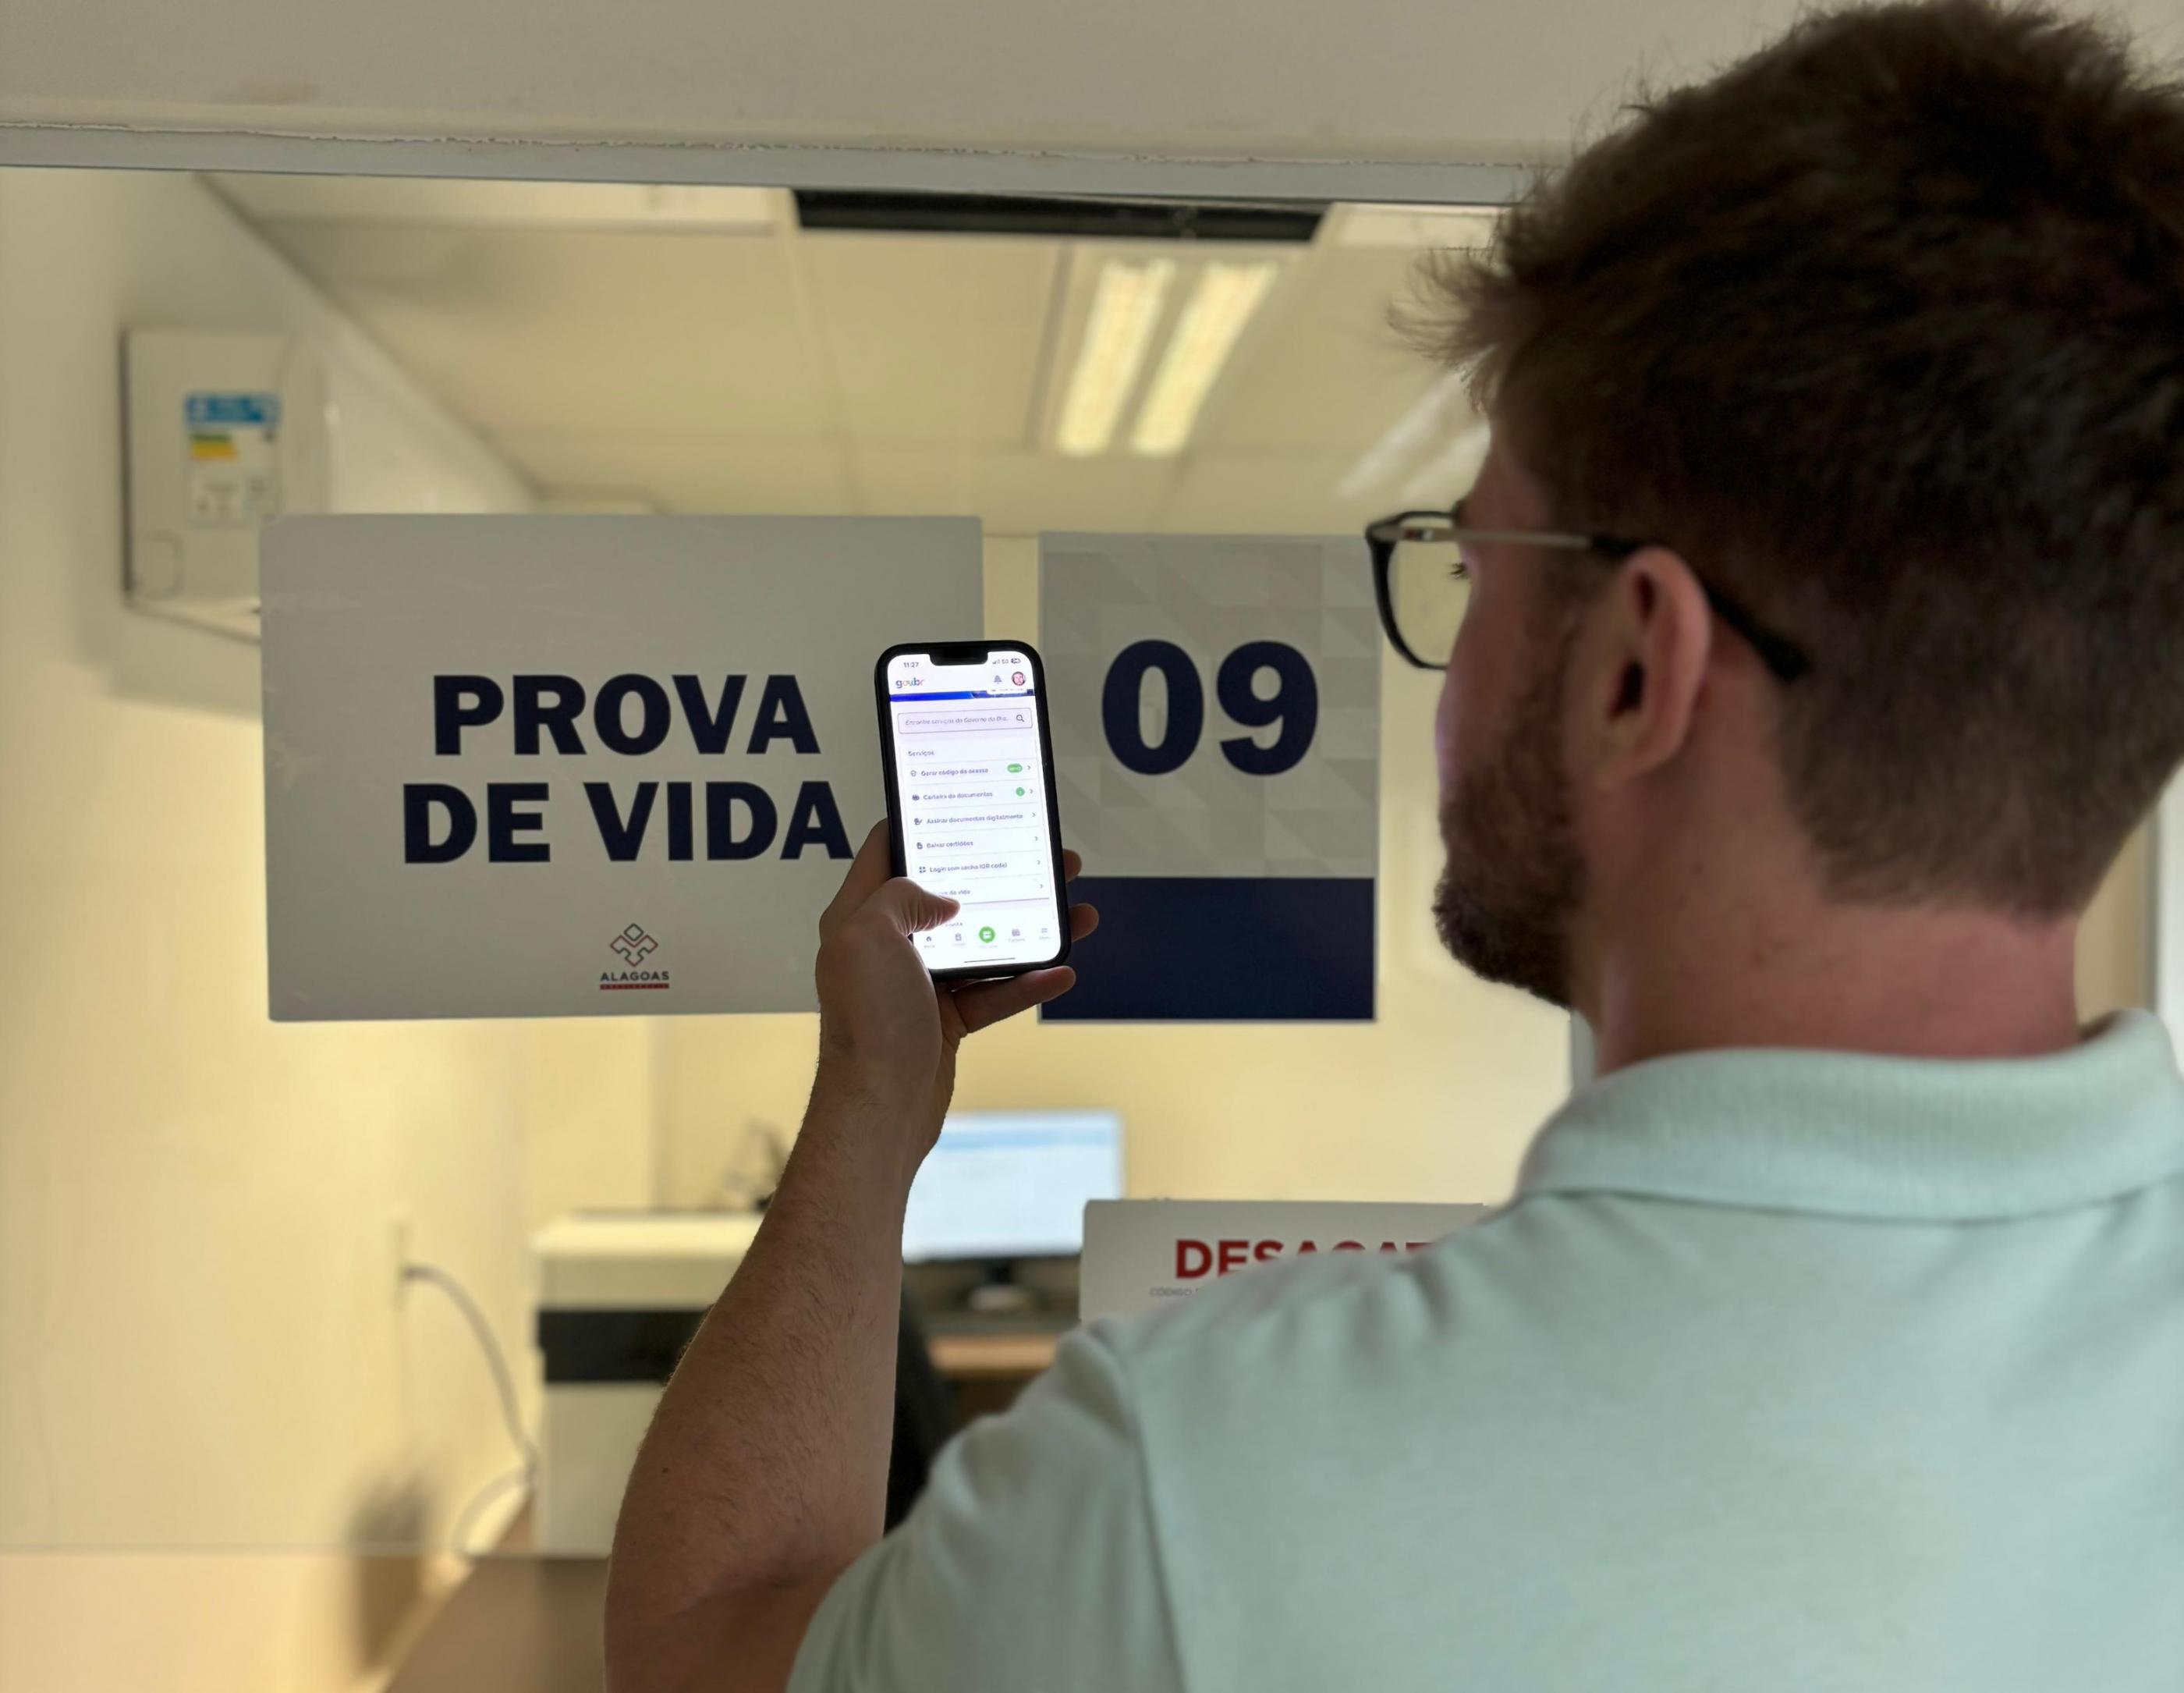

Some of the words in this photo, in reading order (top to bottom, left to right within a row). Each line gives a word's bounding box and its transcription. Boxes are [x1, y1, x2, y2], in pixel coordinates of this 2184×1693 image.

[434, 673, 821, 755] PROVA
[1101, 639, 1318, 776] 09
[403, 783, 551, 863] DE
[583, 781, 855, 861] VIDA
[600, 971, 670, 981] ALAGOAS
